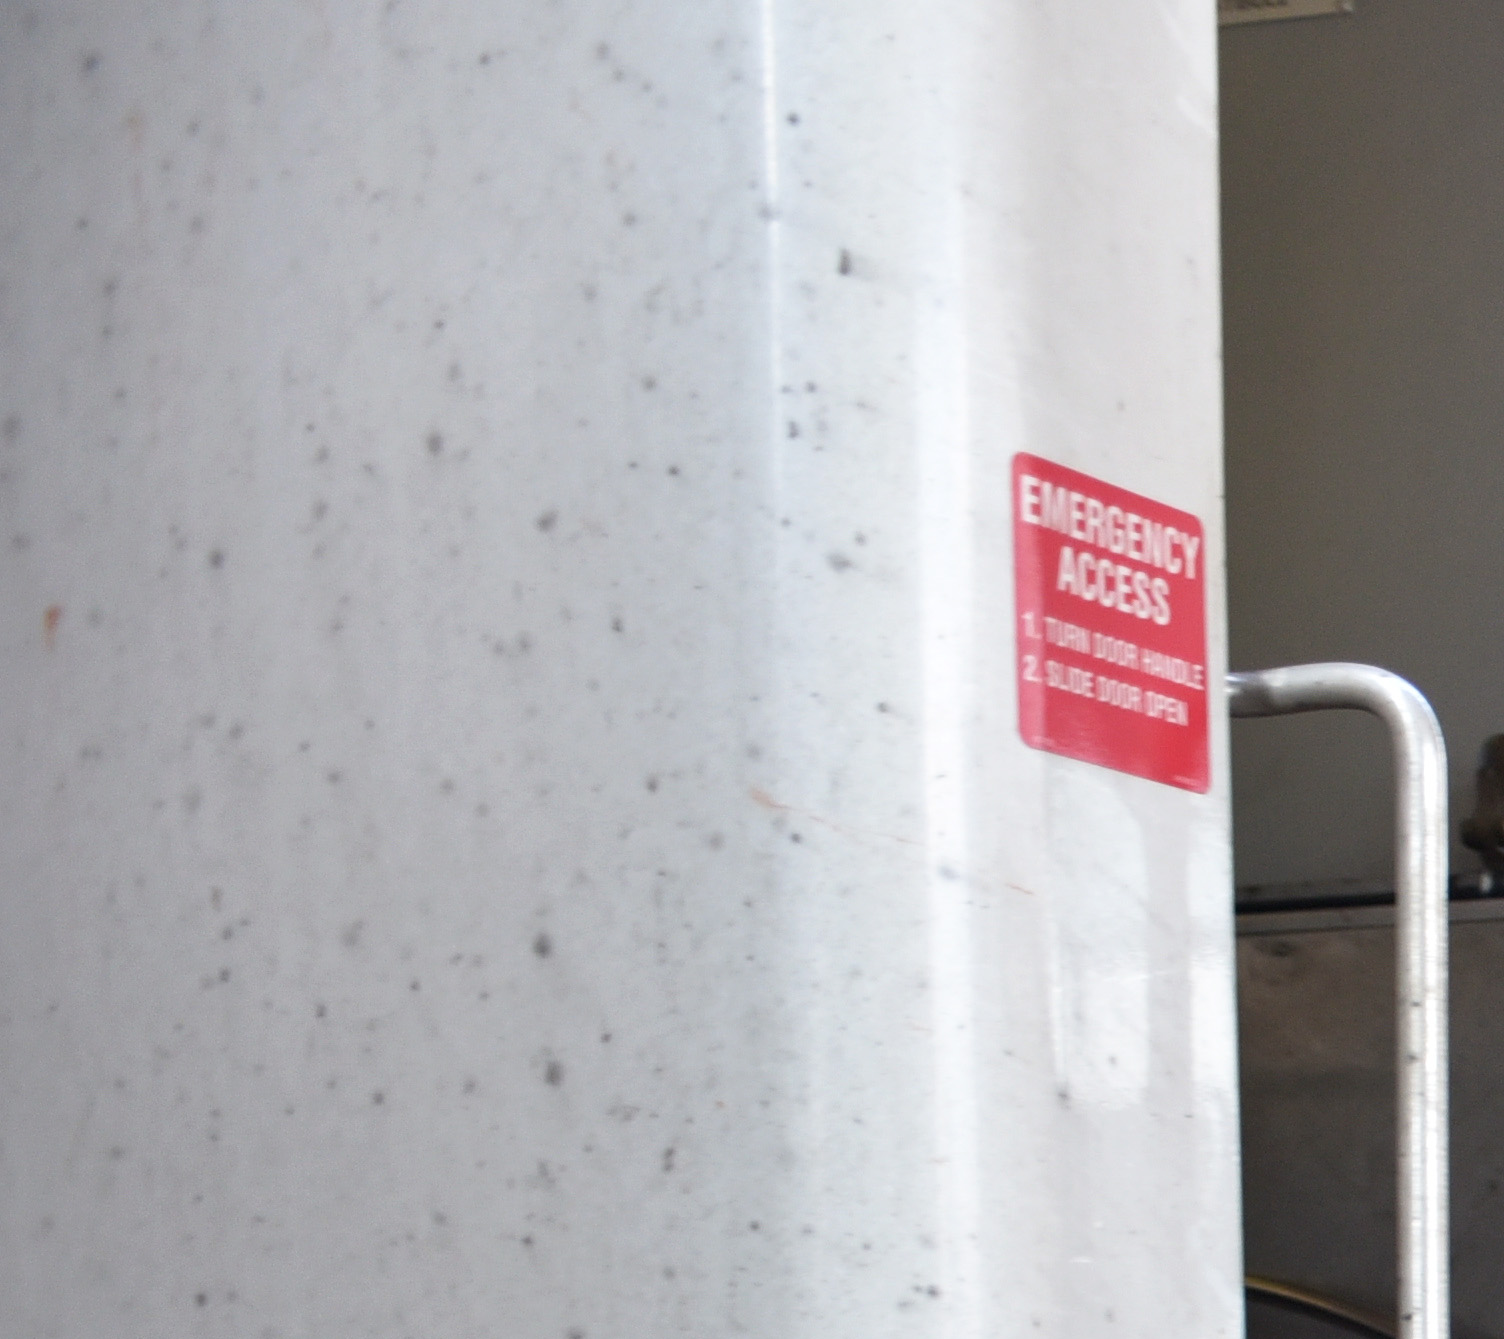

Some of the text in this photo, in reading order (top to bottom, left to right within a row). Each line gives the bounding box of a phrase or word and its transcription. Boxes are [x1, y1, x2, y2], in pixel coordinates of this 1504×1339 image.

[1021, 475, 1199, 579] EMERGENCY
[1057, 546, 1170, 625] ACCESS
[1044, 617, 1091, 655] TURN
[1091, 632, 1140, 671] DOOR
[1140, 648, 1204, 691] HANDLE
[1045, 660, 1095, 698] SLIDE
[1095, 675, 1143, 713] DOOR
[1144, 690, 1188, 727] OPEN
